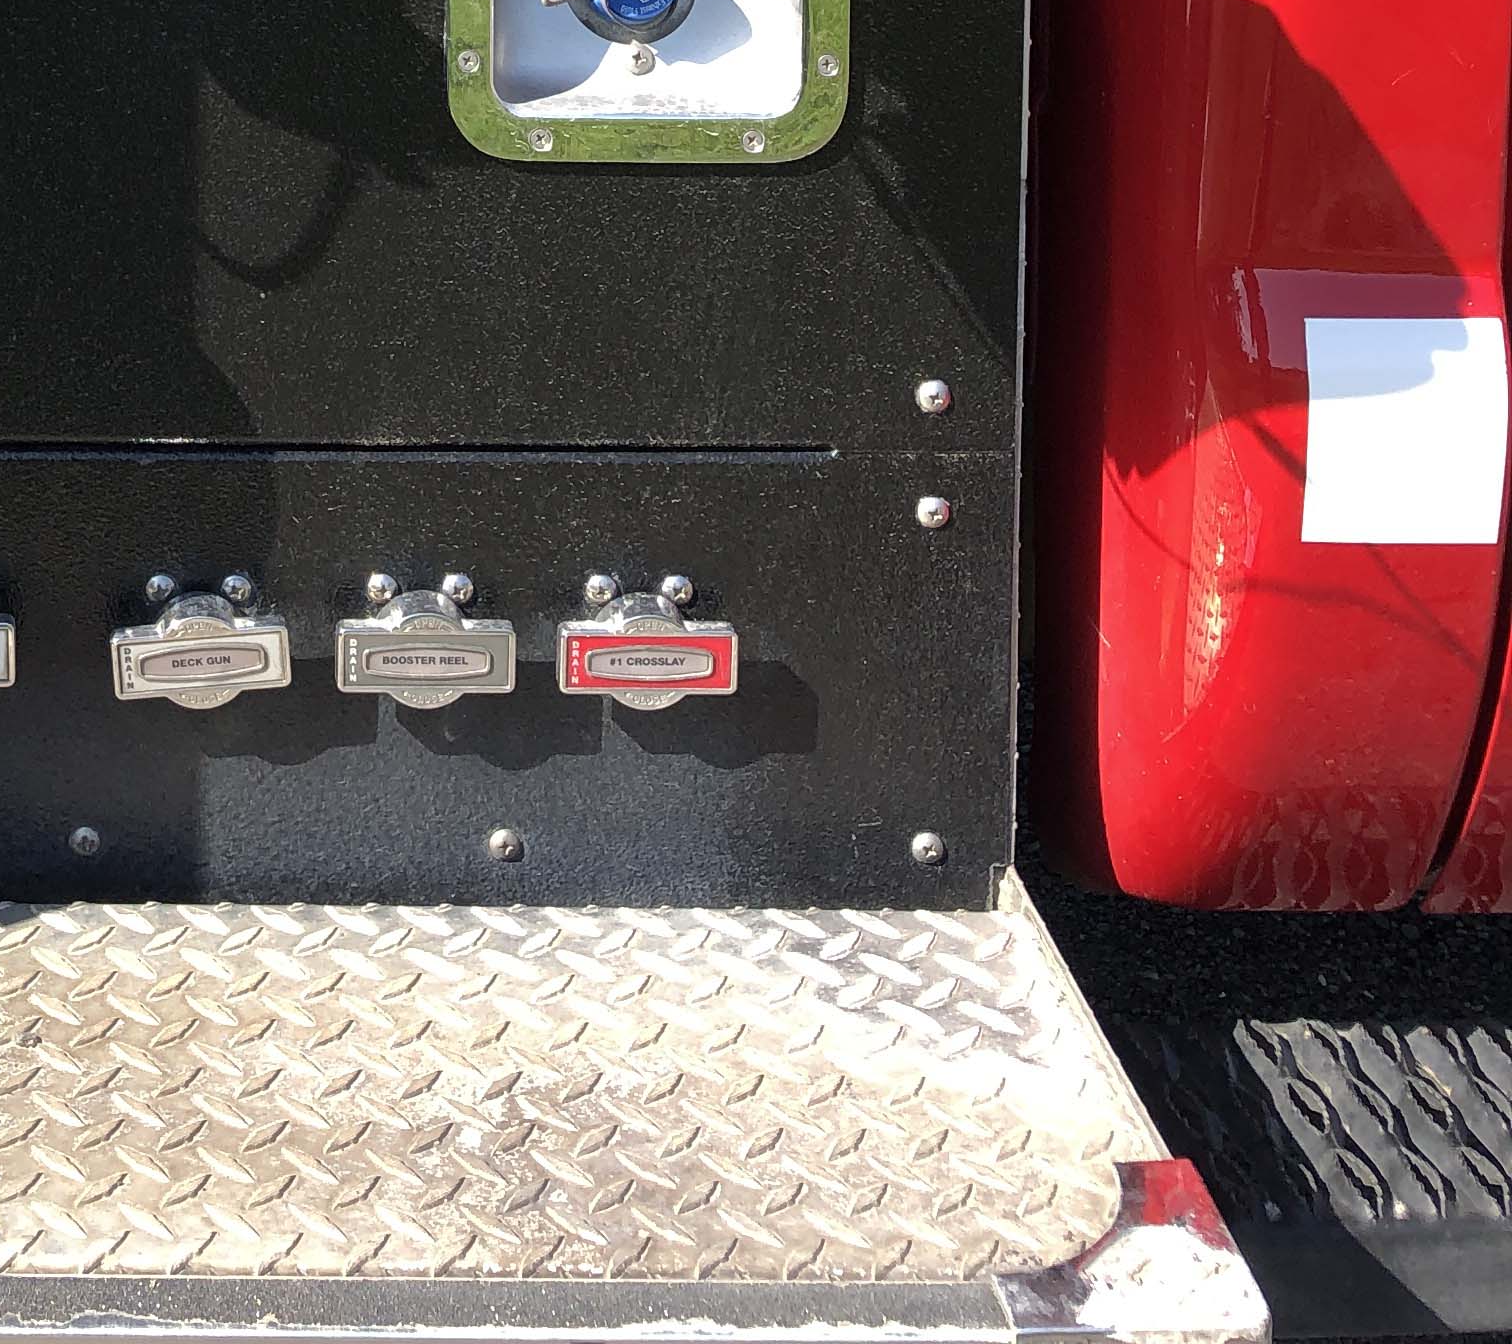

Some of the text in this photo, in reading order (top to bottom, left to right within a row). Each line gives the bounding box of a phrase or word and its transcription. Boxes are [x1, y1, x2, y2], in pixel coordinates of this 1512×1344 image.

[124, 647, 134, 689] DRAIN
[171, 655, 231, 668] DECK GUN
[350, 638, 358, 682] DRAIN
[382, 656, 469, 665] BOOSTER REEL
[571, 640, 580, 684] DRAIN
[610, 657, 687, 666] #1 CROSSLAY
